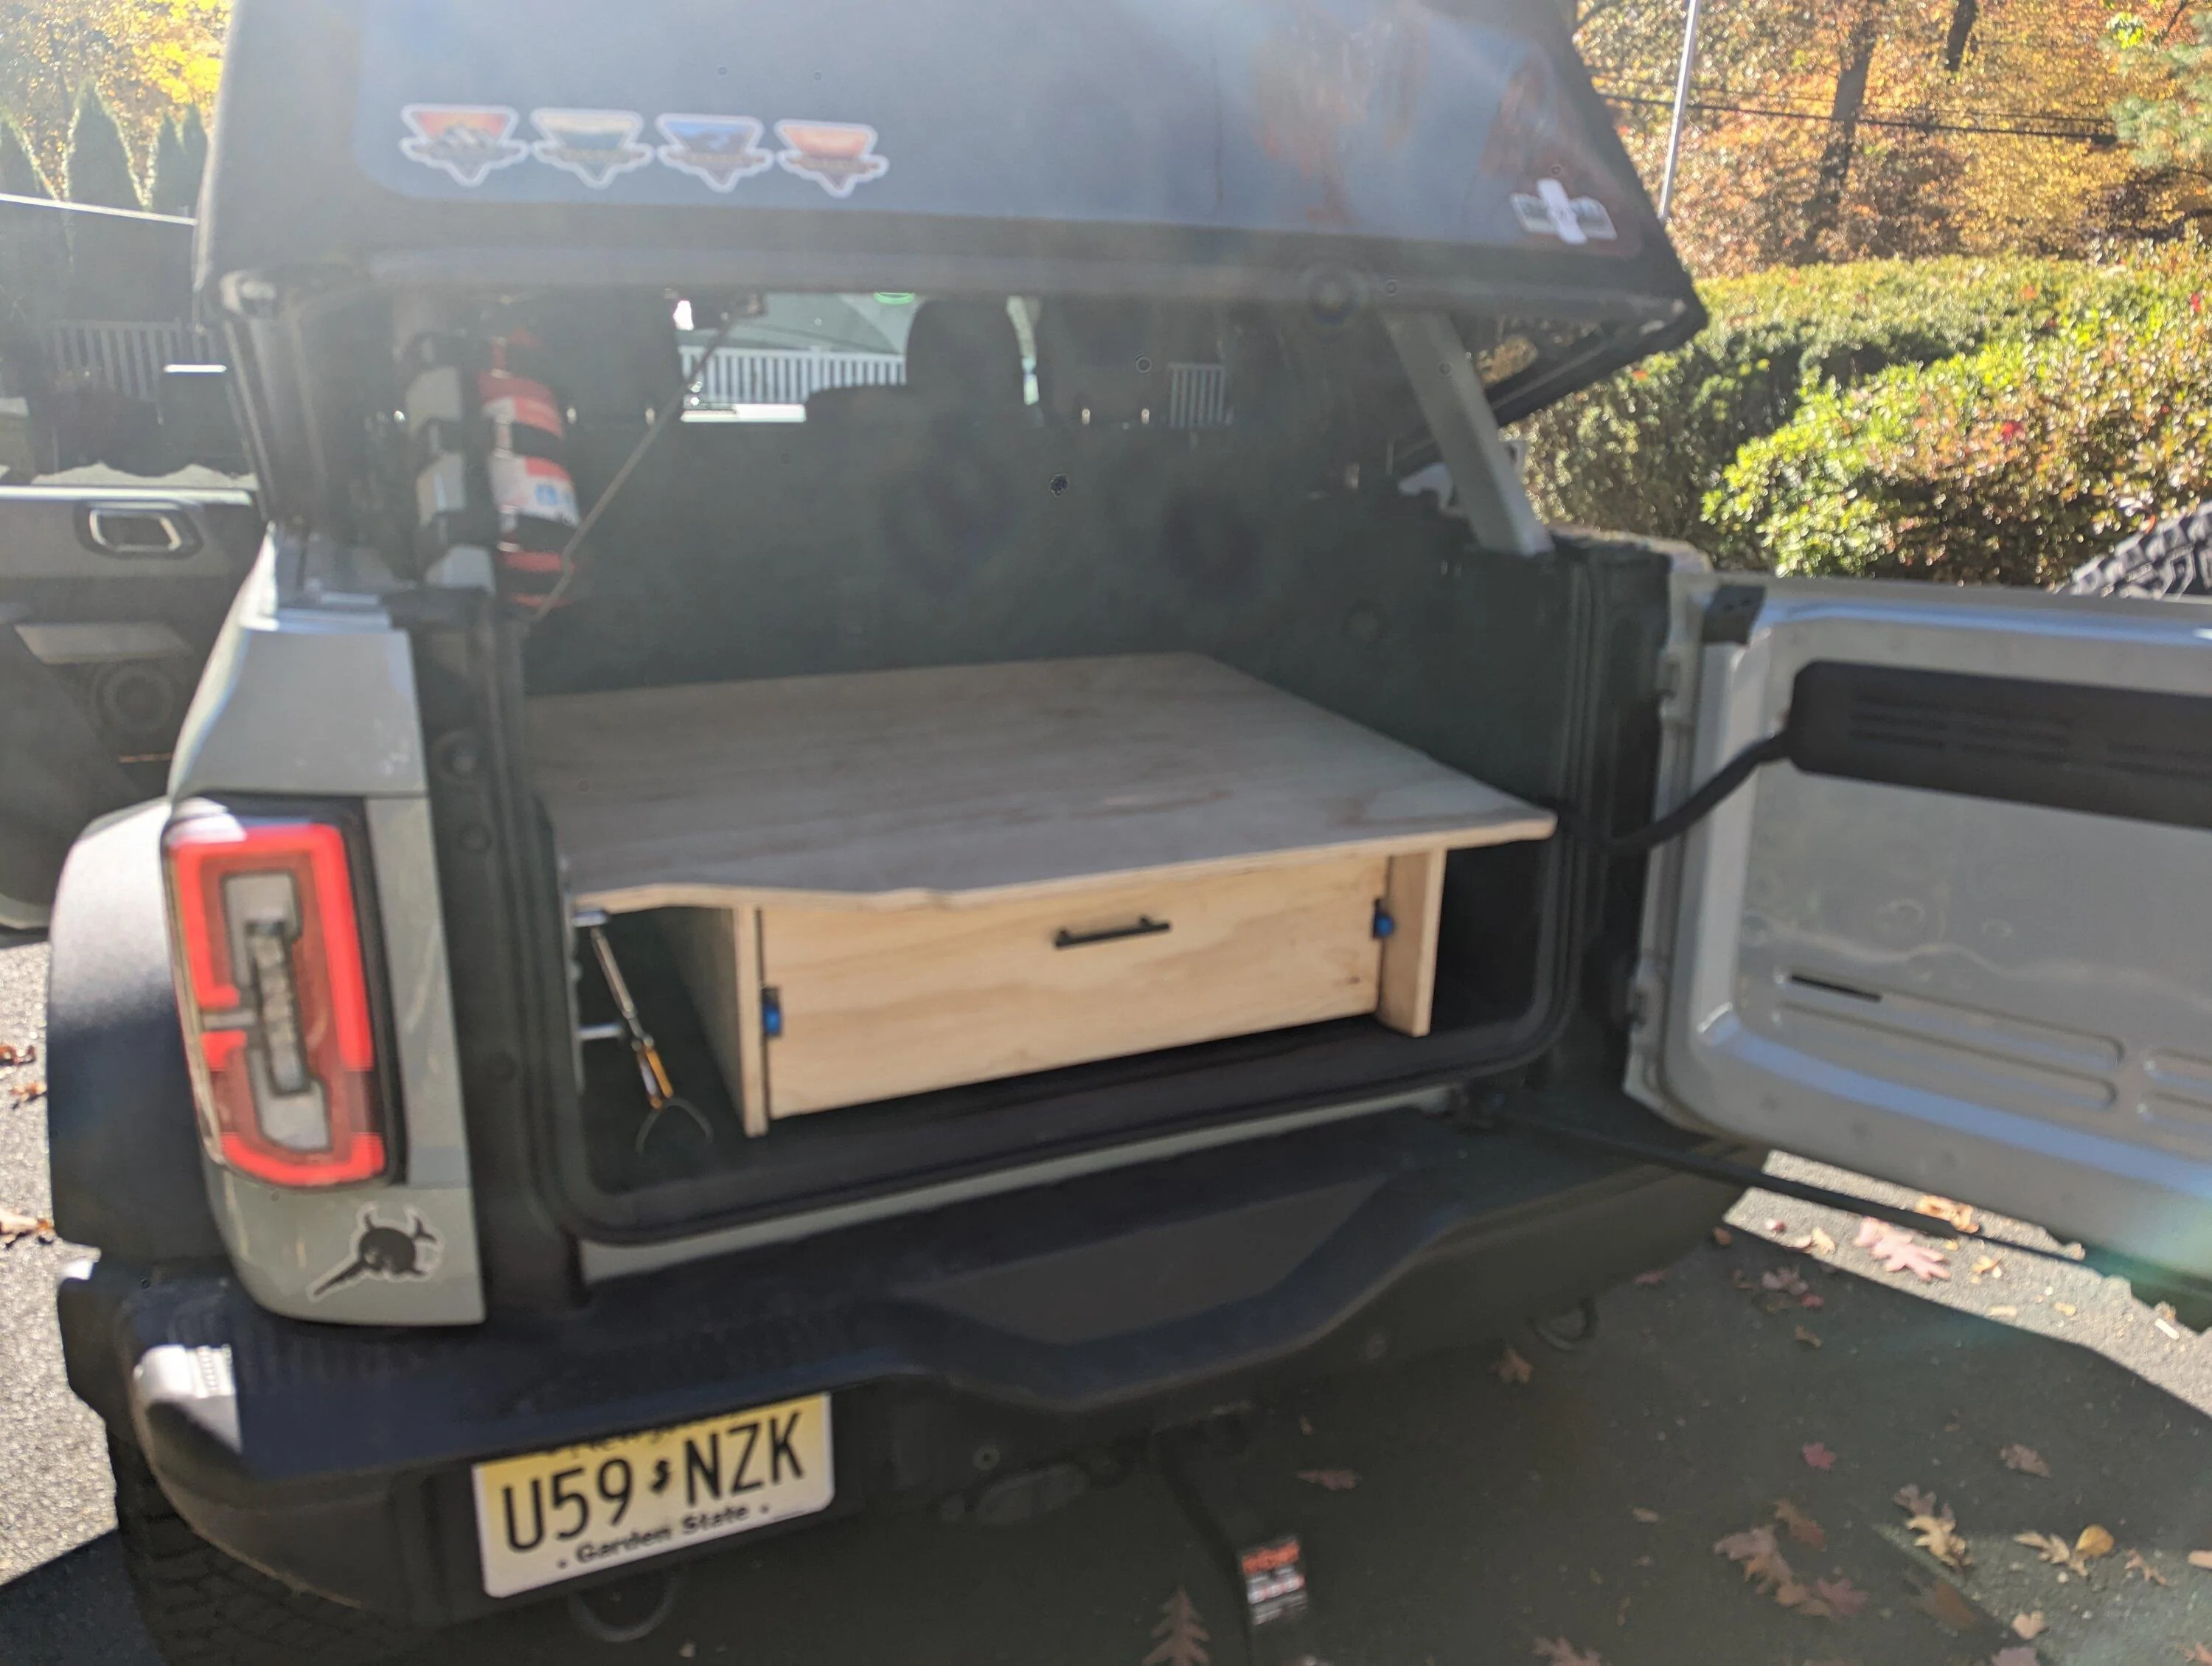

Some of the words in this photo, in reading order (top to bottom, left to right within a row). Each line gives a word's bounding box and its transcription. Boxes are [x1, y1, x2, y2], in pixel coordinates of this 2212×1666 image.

[501, 1458, 633, 1554] U59
[684, 1410, 804, 1507] NZK
[576, 1525, 672, 1563] Garden
[682, 1506, 750, 1535] State
